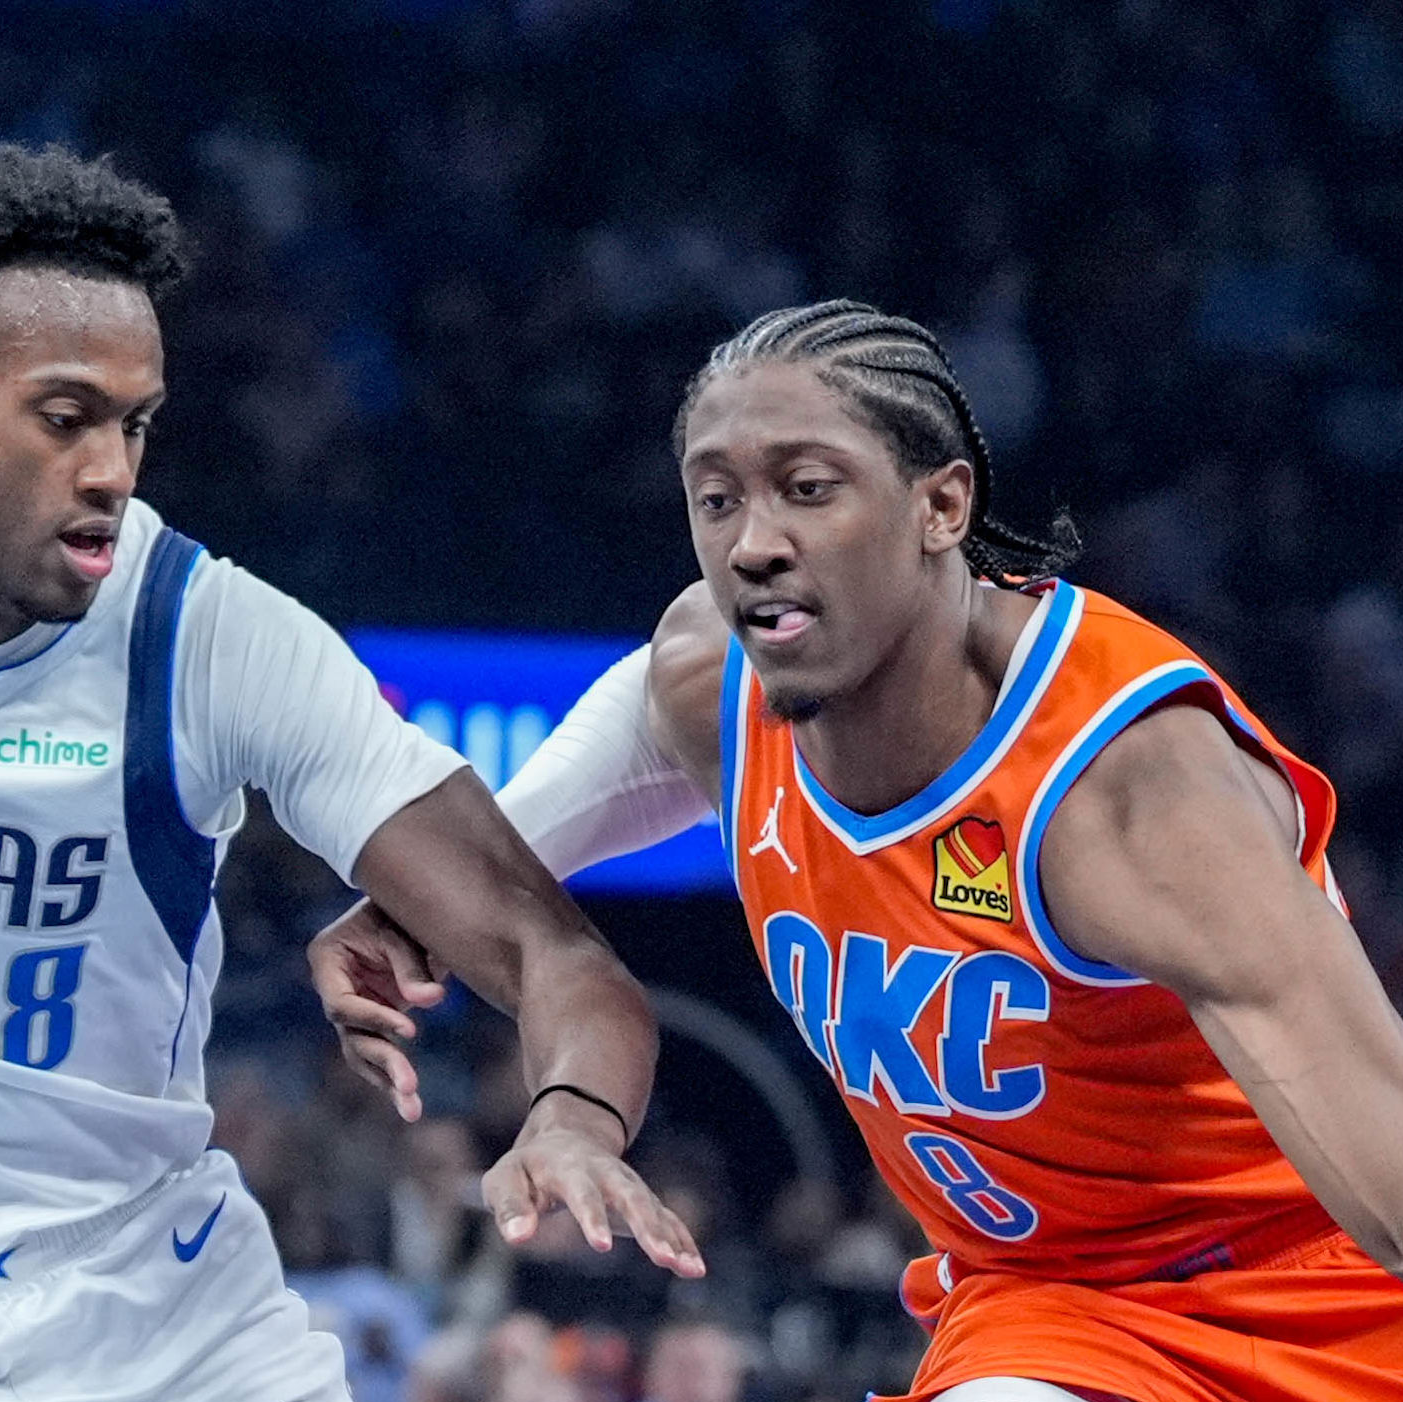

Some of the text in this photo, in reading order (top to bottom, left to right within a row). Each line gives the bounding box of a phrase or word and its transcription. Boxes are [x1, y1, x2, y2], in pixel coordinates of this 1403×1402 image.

[0, 942, 90, 1072] 8
[763, 910, 1050, 1120] OKC
[904, 1131, 1039, 1242] 8
